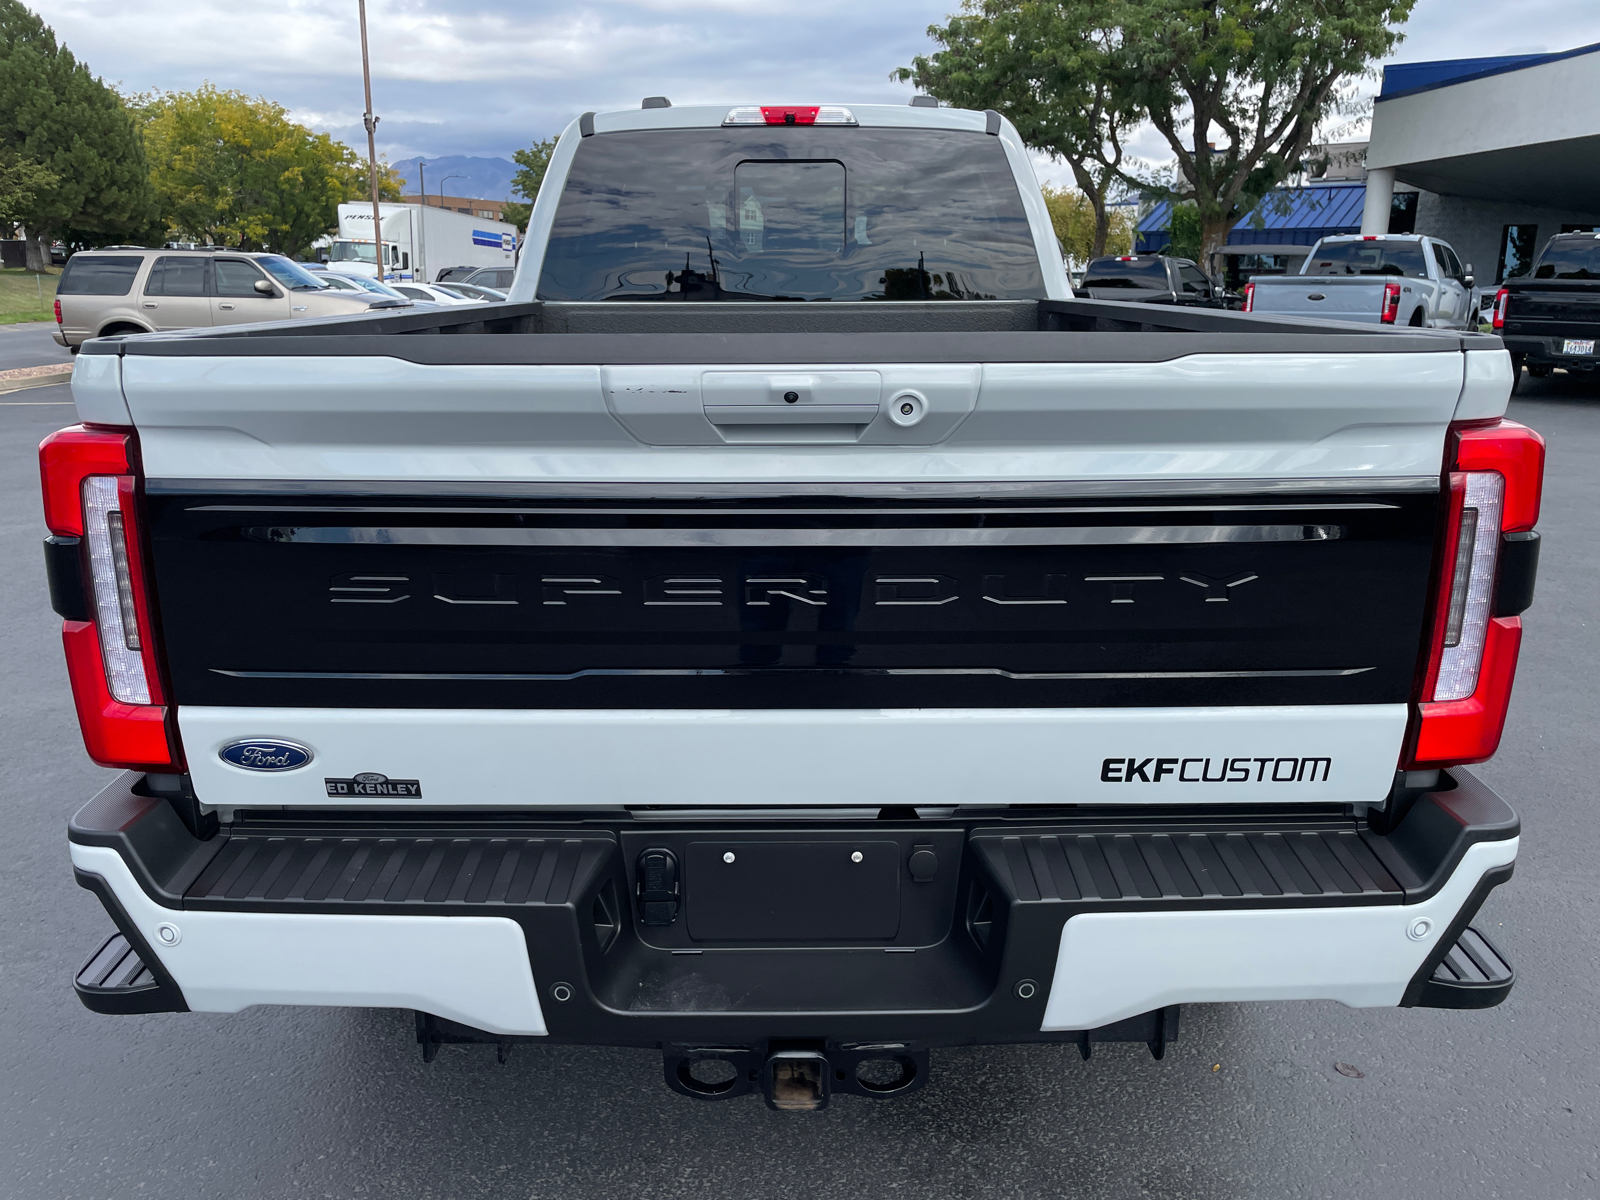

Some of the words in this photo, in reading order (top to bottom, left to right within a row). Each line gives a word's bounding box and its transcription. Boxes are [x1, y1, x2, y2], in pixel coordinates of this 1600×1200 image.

[344, 214, 387, 222] PENSE
[329, 572, 828, 605] SUPER
[874, 569, 1259, 605] DUTY
[240, 746, 290, 767] Ford
[326, 783, 349, 794] ED
[353, 783, 419, 795] KENLEY
